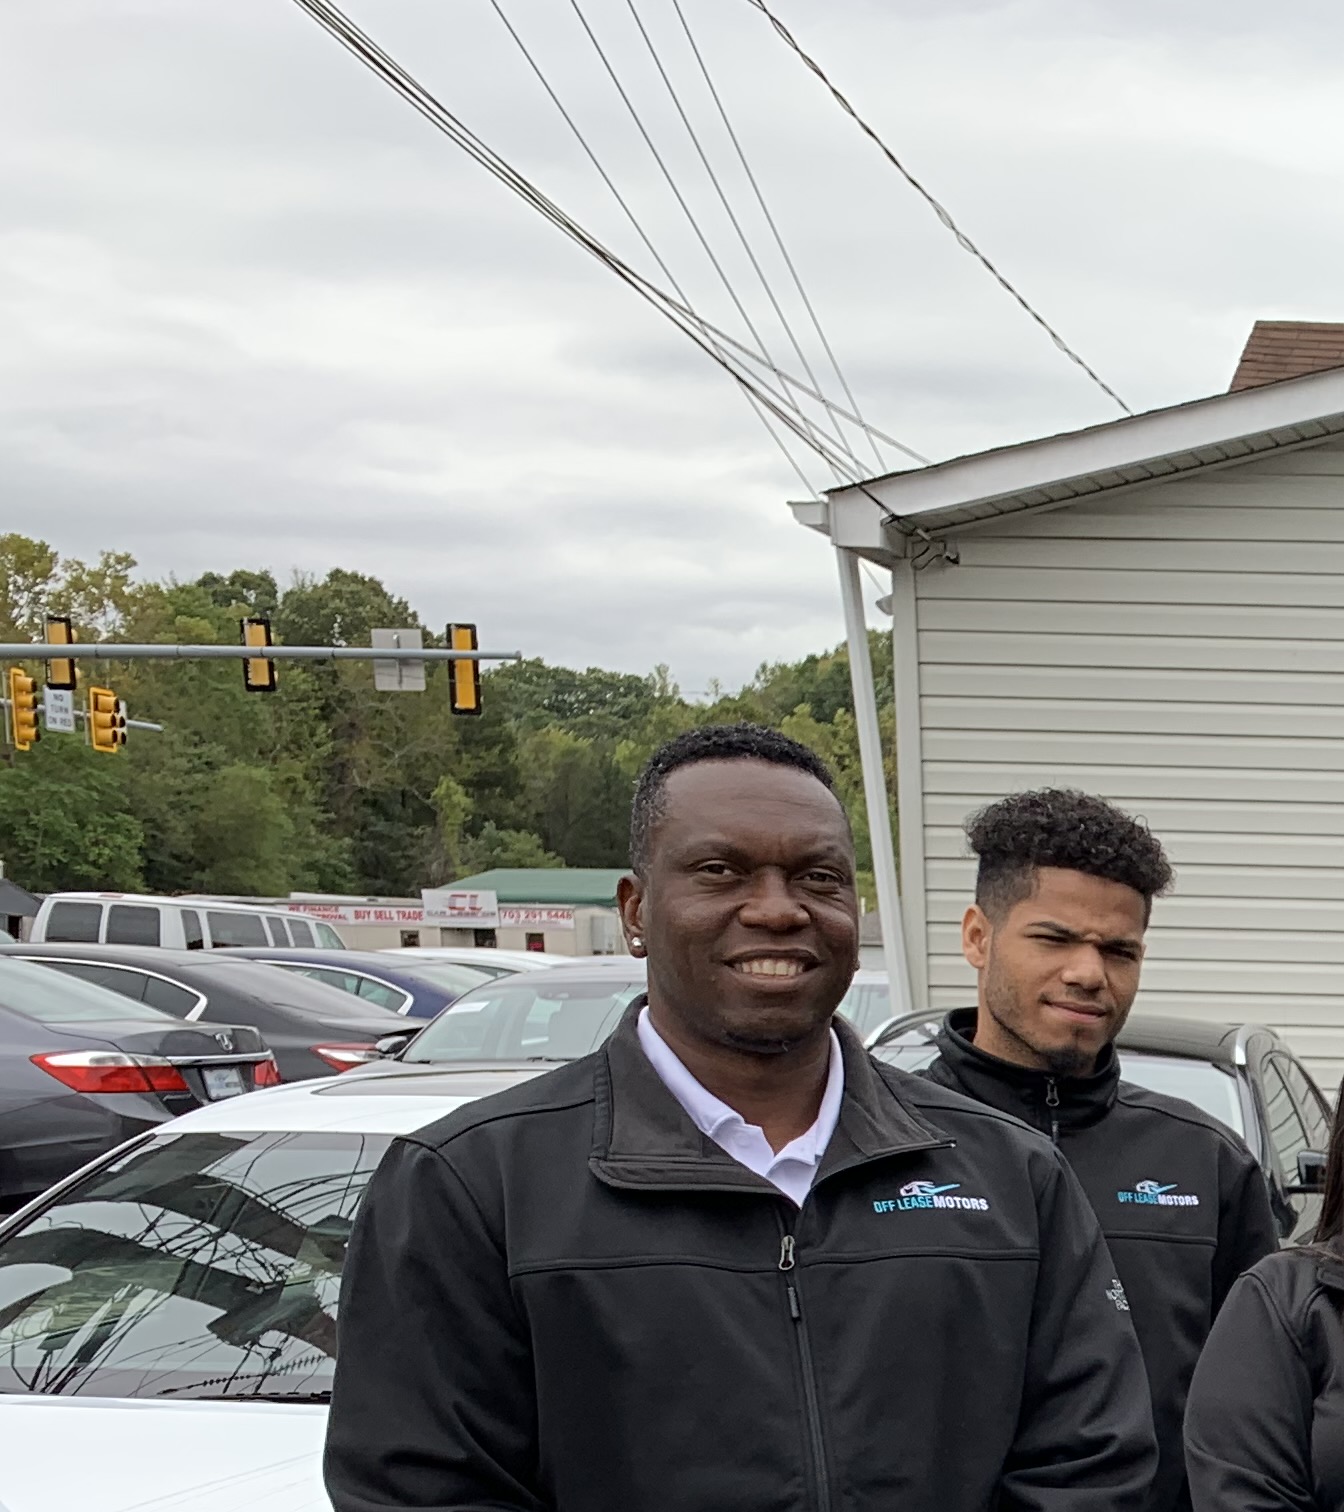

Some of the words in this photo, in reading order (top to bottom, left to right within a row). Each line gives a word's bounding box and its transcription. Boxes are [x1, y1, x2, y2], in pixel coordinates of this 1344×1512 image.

[354, 909, 371, 920] BUY
[374, 909, 394, 920] SELL
[396, 909, 424, 921] TRADE
[873, 1200, 896, 1213] OFF
[897, 1196, 933, 1210] LEASE
[932, 1195, 989, 1211] MOTORS
[1117, 1191, 1133, 1203] OFF
[1134, 1192, 1158, 1204] LEASE
[1157, 1194, 1199, 1206] MOTORS
